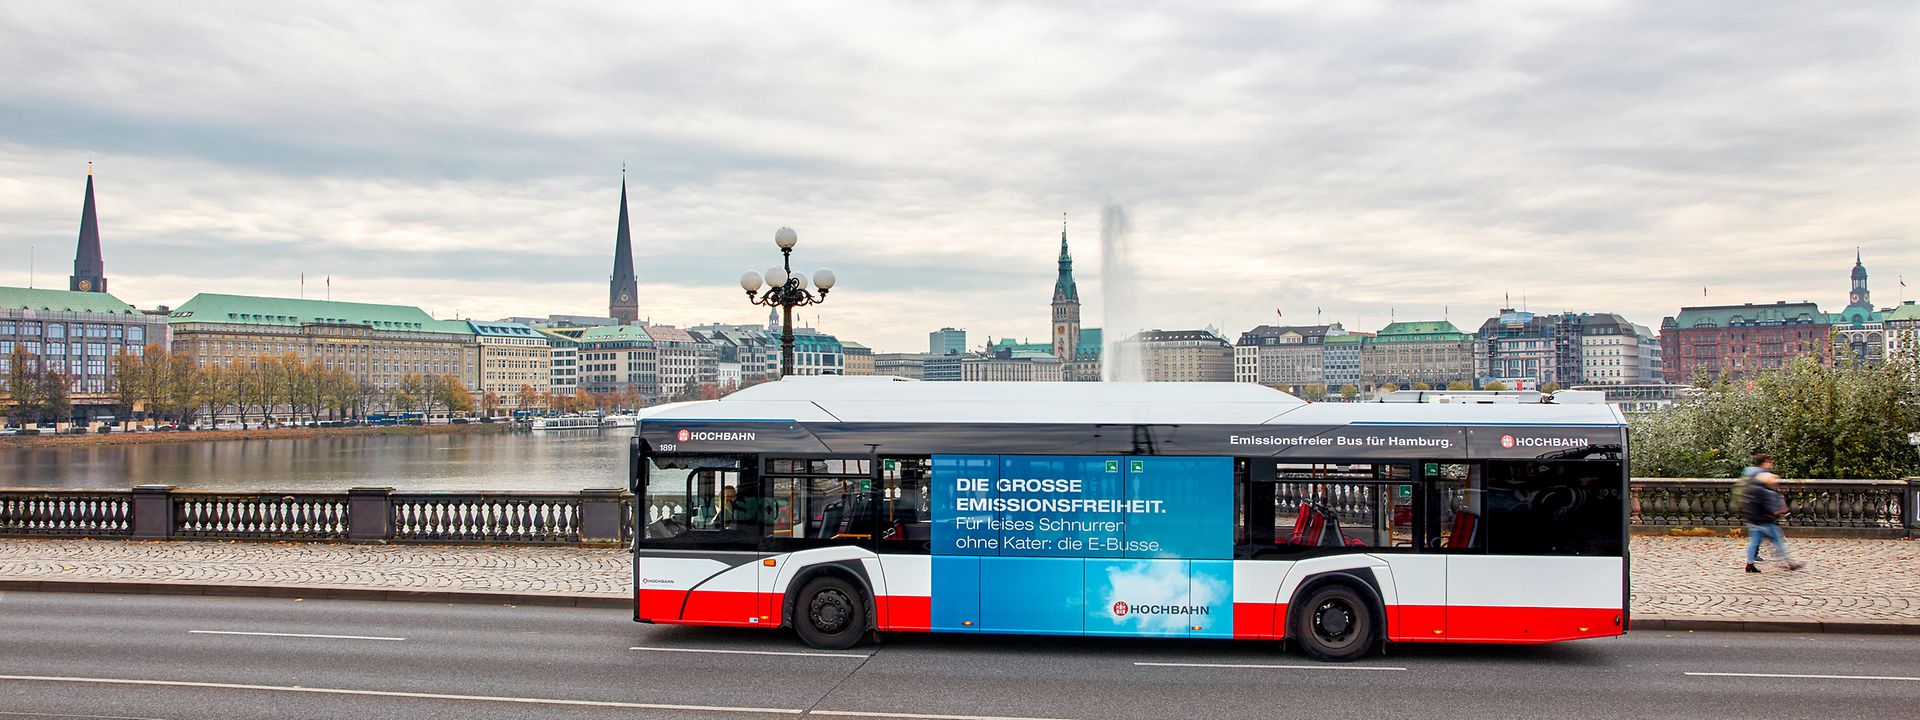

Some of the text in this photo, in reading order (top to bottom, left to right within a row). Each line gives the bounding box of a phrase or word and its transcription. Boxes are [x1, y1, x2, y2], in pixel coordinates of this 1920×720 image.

[691, 432, 755, 440] HOCHBAHN
[1230, 435, 1453, 448] Emissionsfreier Bus für Hamburg.
[1516, 438, 1588, 447] HOCHBAHN
[956, 478, 1082, 493] DIE GROSSE
[956, 498, 1166, 513] EMISSIONSFREIHEIT.
[956, 517, 1126, 532] Für leises Schnurren
[956, 536, 1163, 551] ohne Kater: die E-Busse.
[1130, 605, 1210, 615] HOCHBAHN
